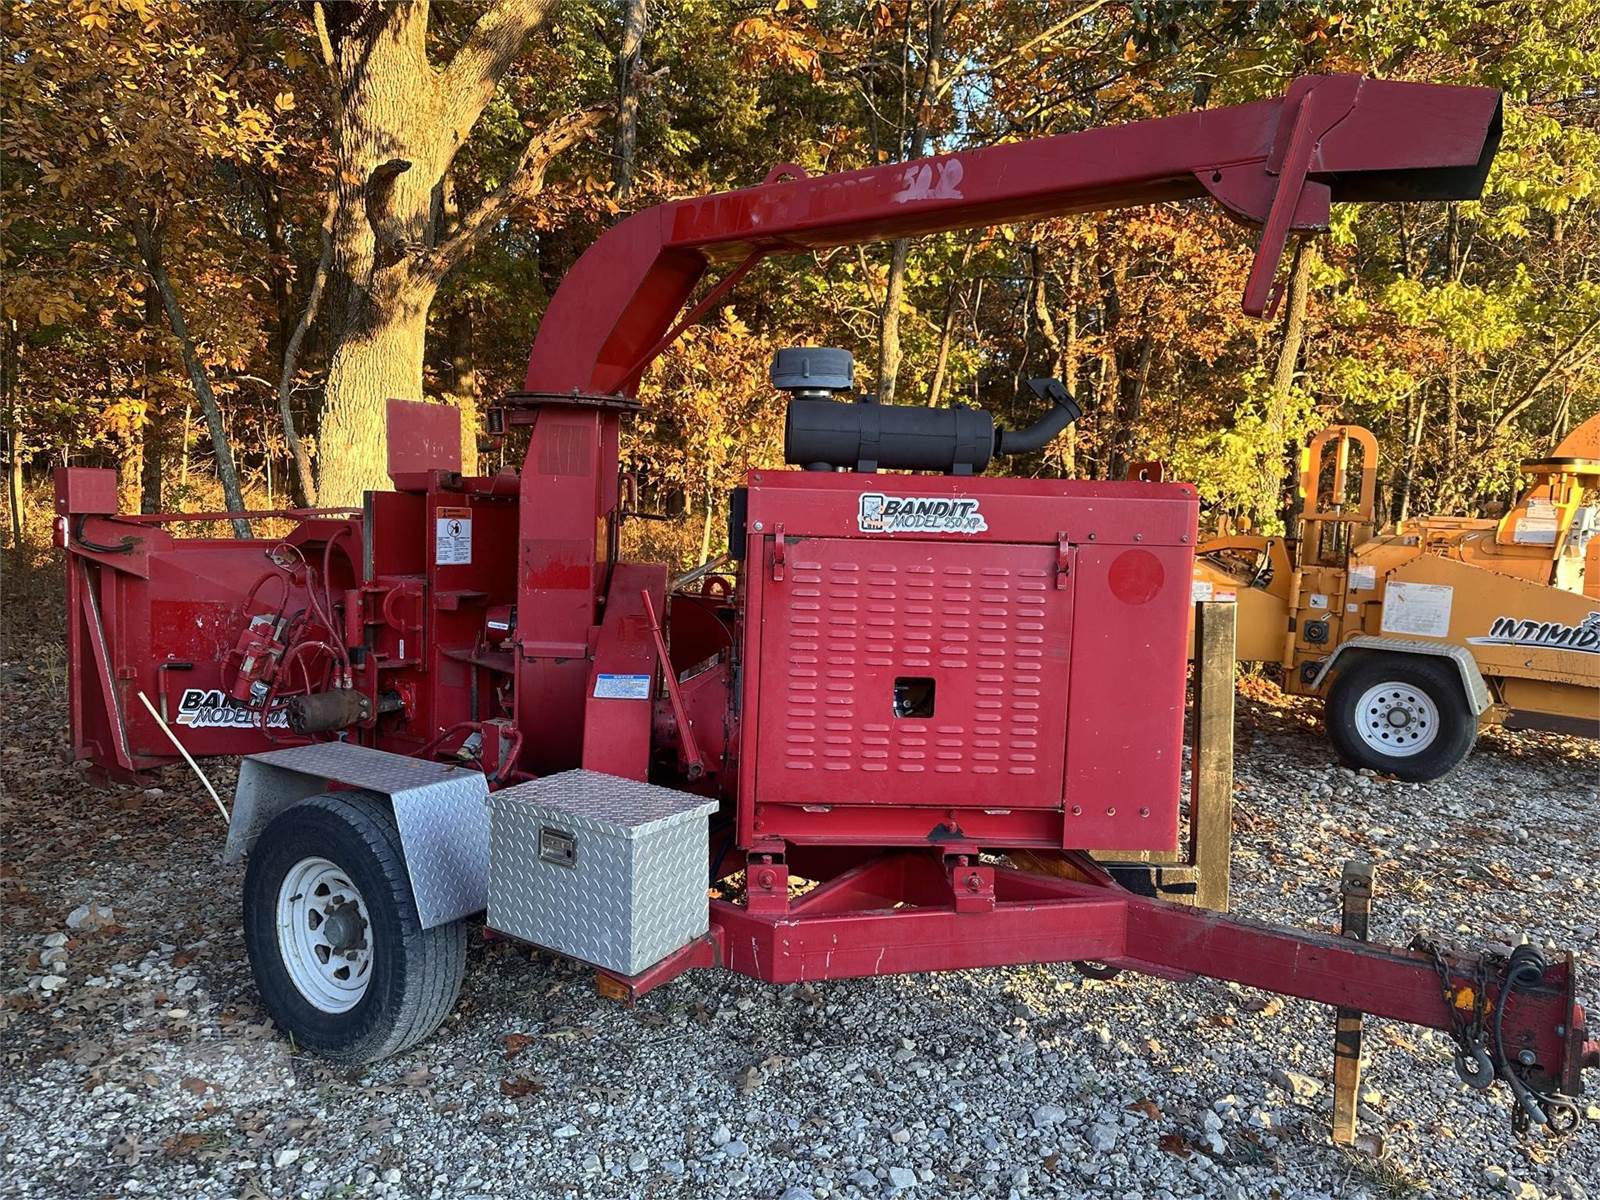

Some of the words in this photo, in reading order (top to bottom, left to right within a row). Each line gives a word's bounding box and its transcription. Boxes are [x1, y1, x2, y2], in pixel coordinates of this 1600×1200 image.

[883, 500, 976, 517] BANDIT
[888, 513, 941, 529] MODEL
[944, 516, 963, 529] 250
[1490, 617, 1600, 650] INTIMID
[192, 707, 253, 724] MODEL
